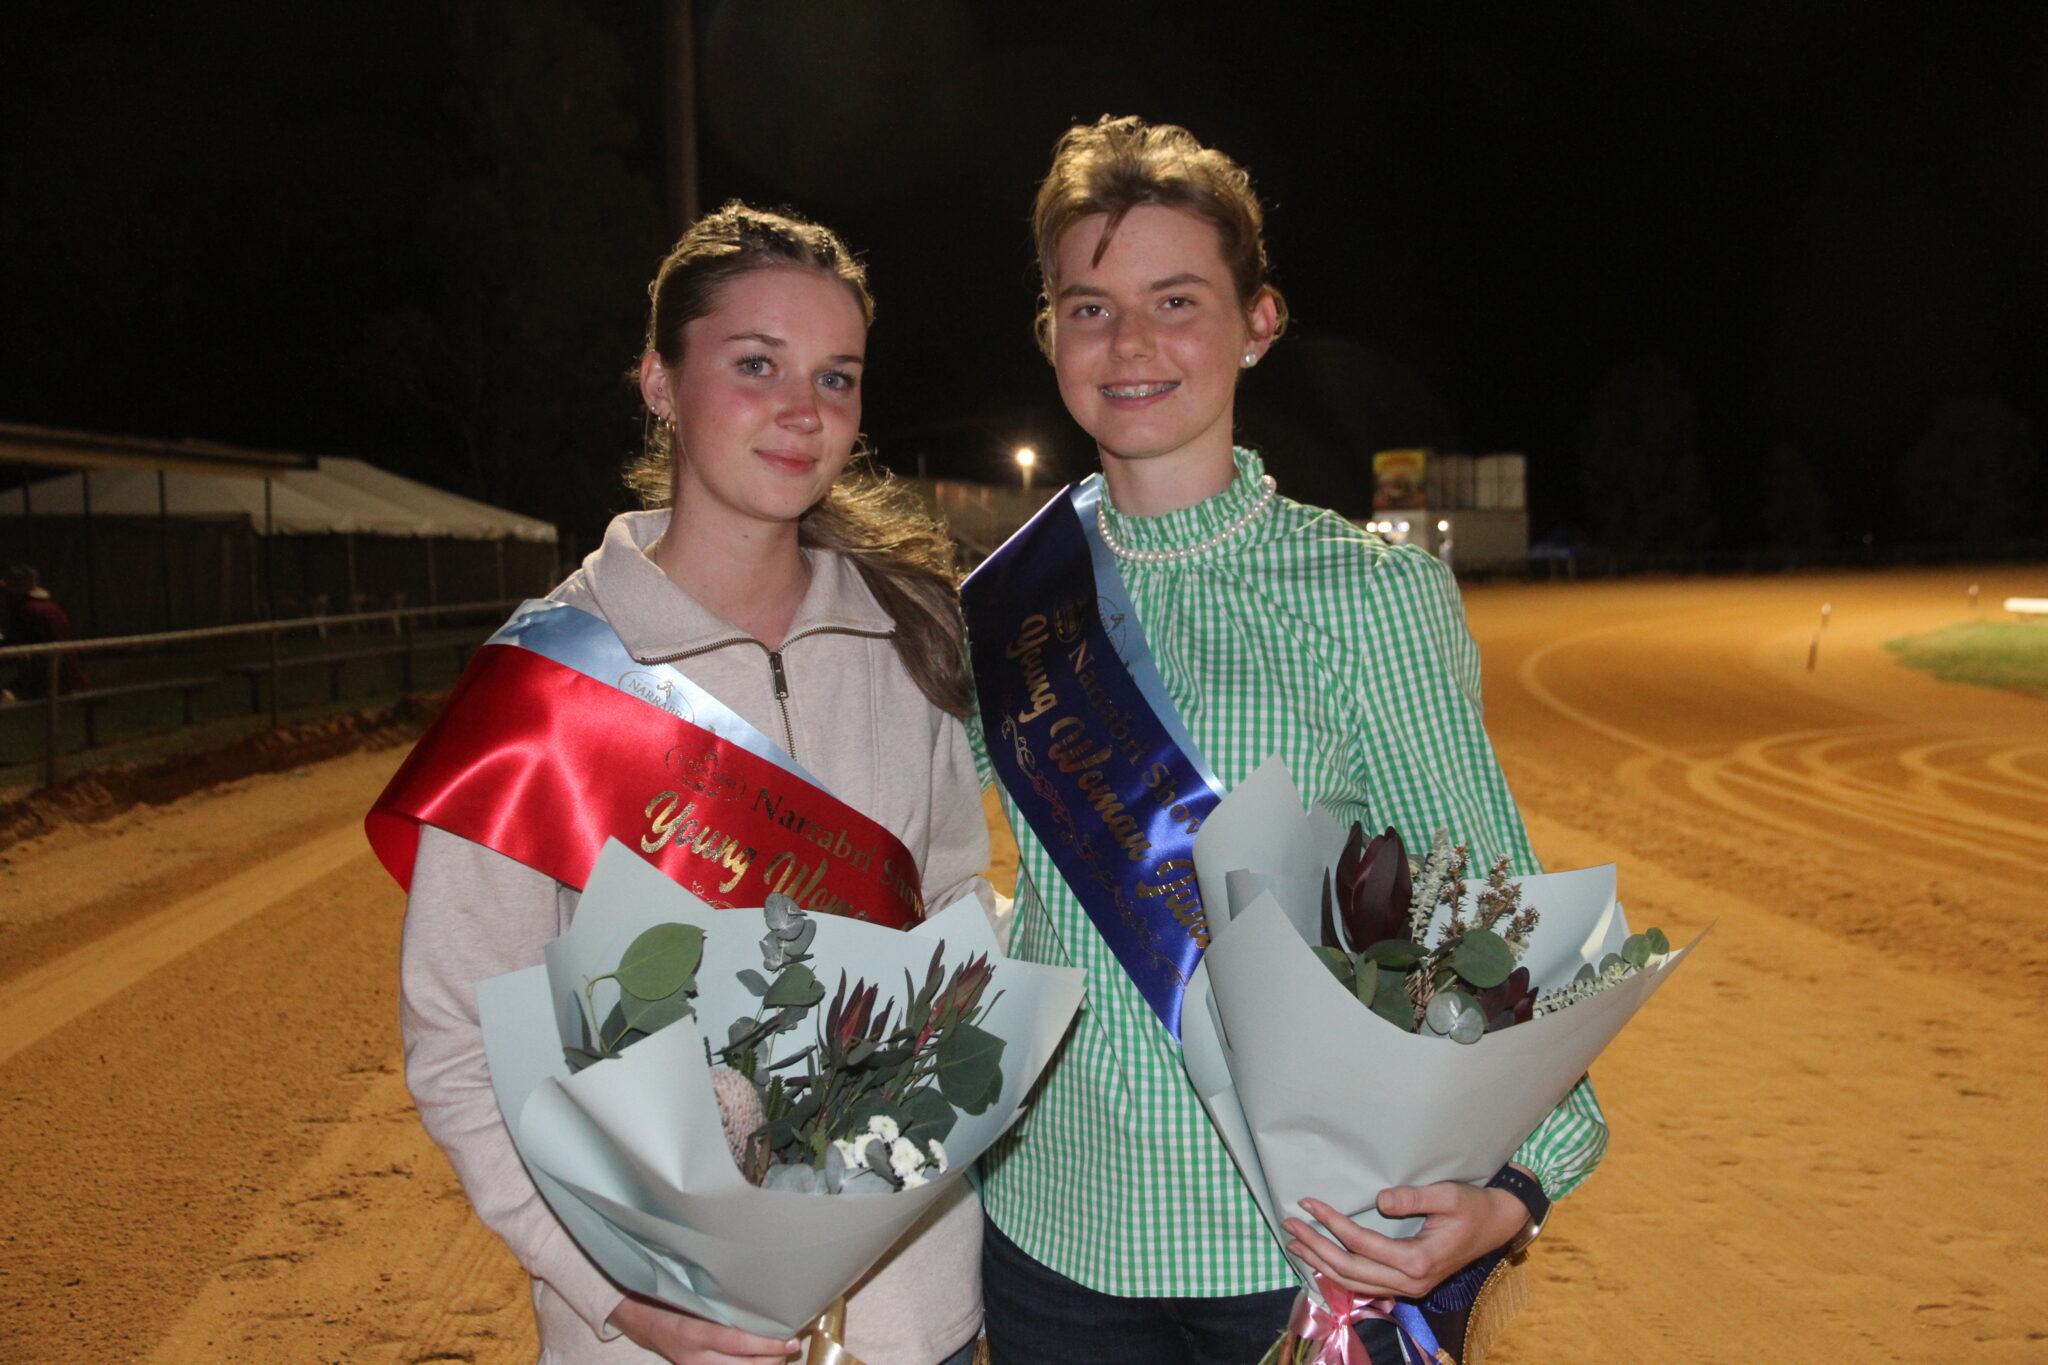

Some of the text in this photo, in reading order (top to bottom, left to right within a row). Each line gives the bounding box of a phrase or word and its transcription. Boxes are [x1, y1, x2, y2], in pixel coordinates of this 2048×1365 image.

[1068, 640, 1152, 764] Narrabri
[640, 790, 758, 894] Young
[1005, 613, 1058, 724] Young
[1047, 716, 1152, 861] Woman
[1135, 859, 1211, 949] Jun
[752, 787, 924, 919] Narrabri Show
